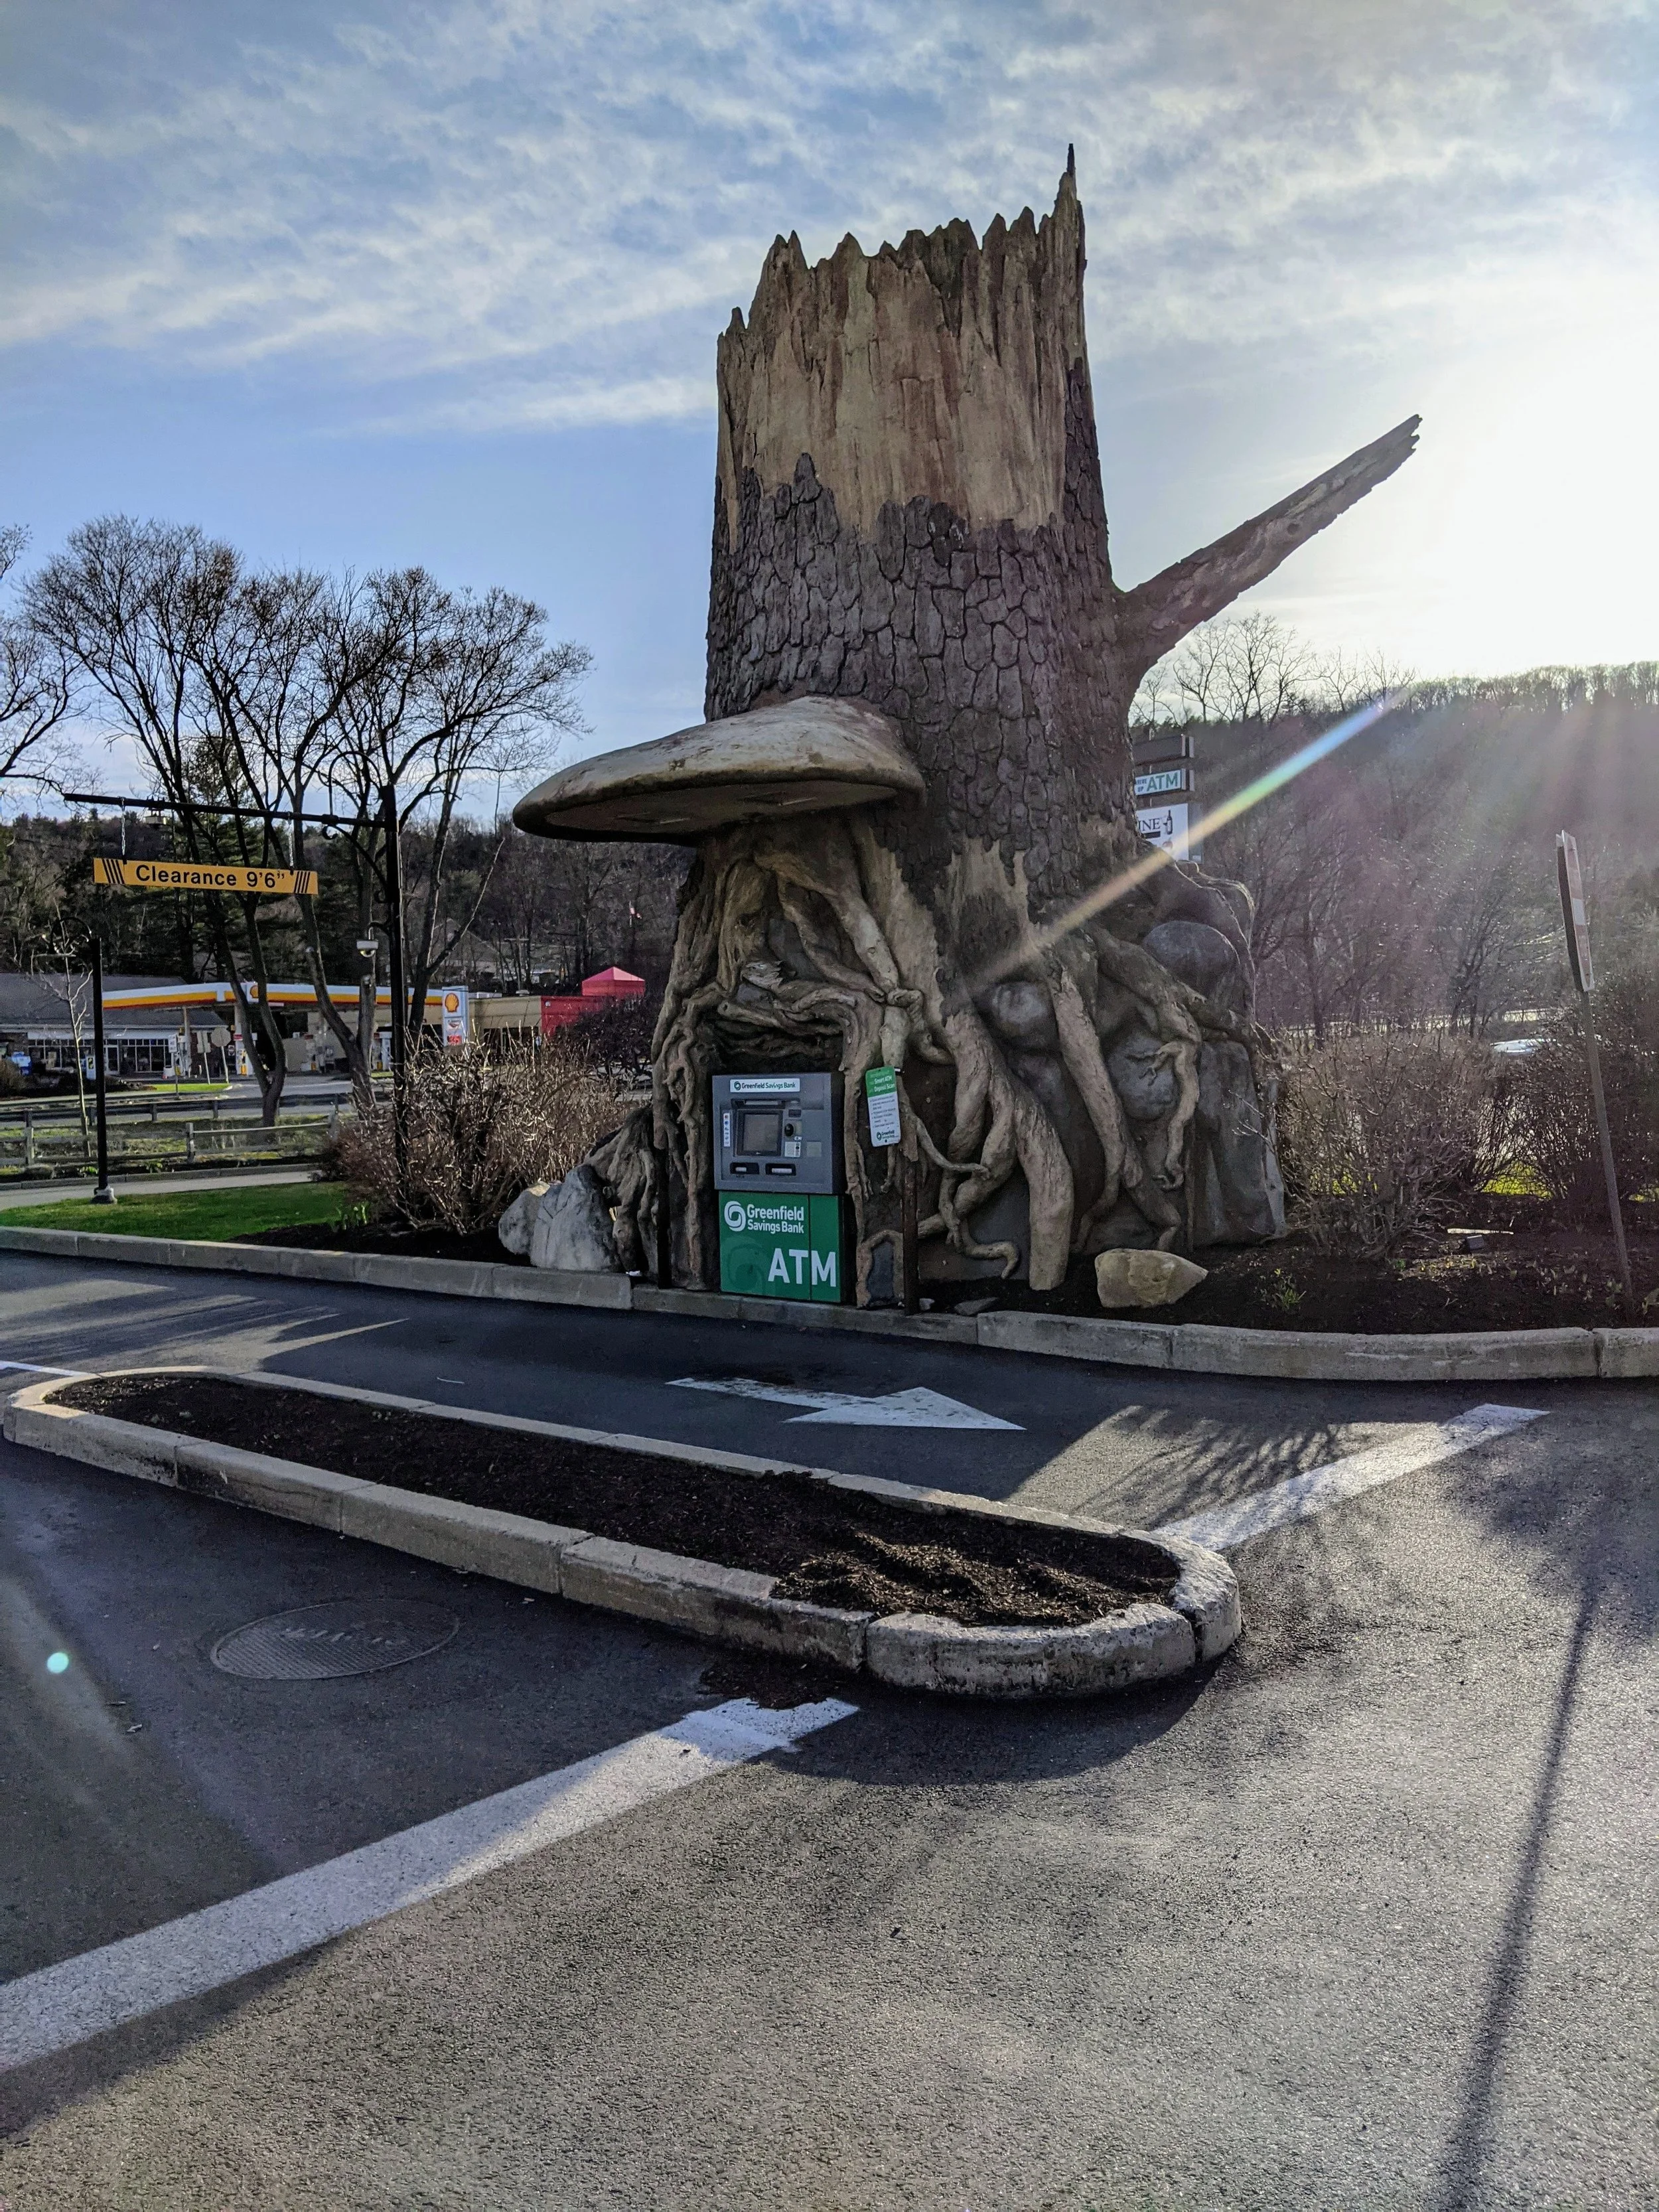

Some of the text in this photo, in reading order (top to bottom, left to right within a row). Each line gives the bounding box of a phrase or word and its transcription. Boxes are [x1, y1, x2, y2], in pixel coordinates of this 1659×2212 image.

[1146, 772, 1178, 792] ATM
[1138, 818, 1161, 832] INE
[136, 864, 237, 886] Clearance
[747, 1204, 804, 1221] Greenfield
[747, 1219, 804, 1234] Savings Bank
[768, 1248, 837, 1288] ATM
